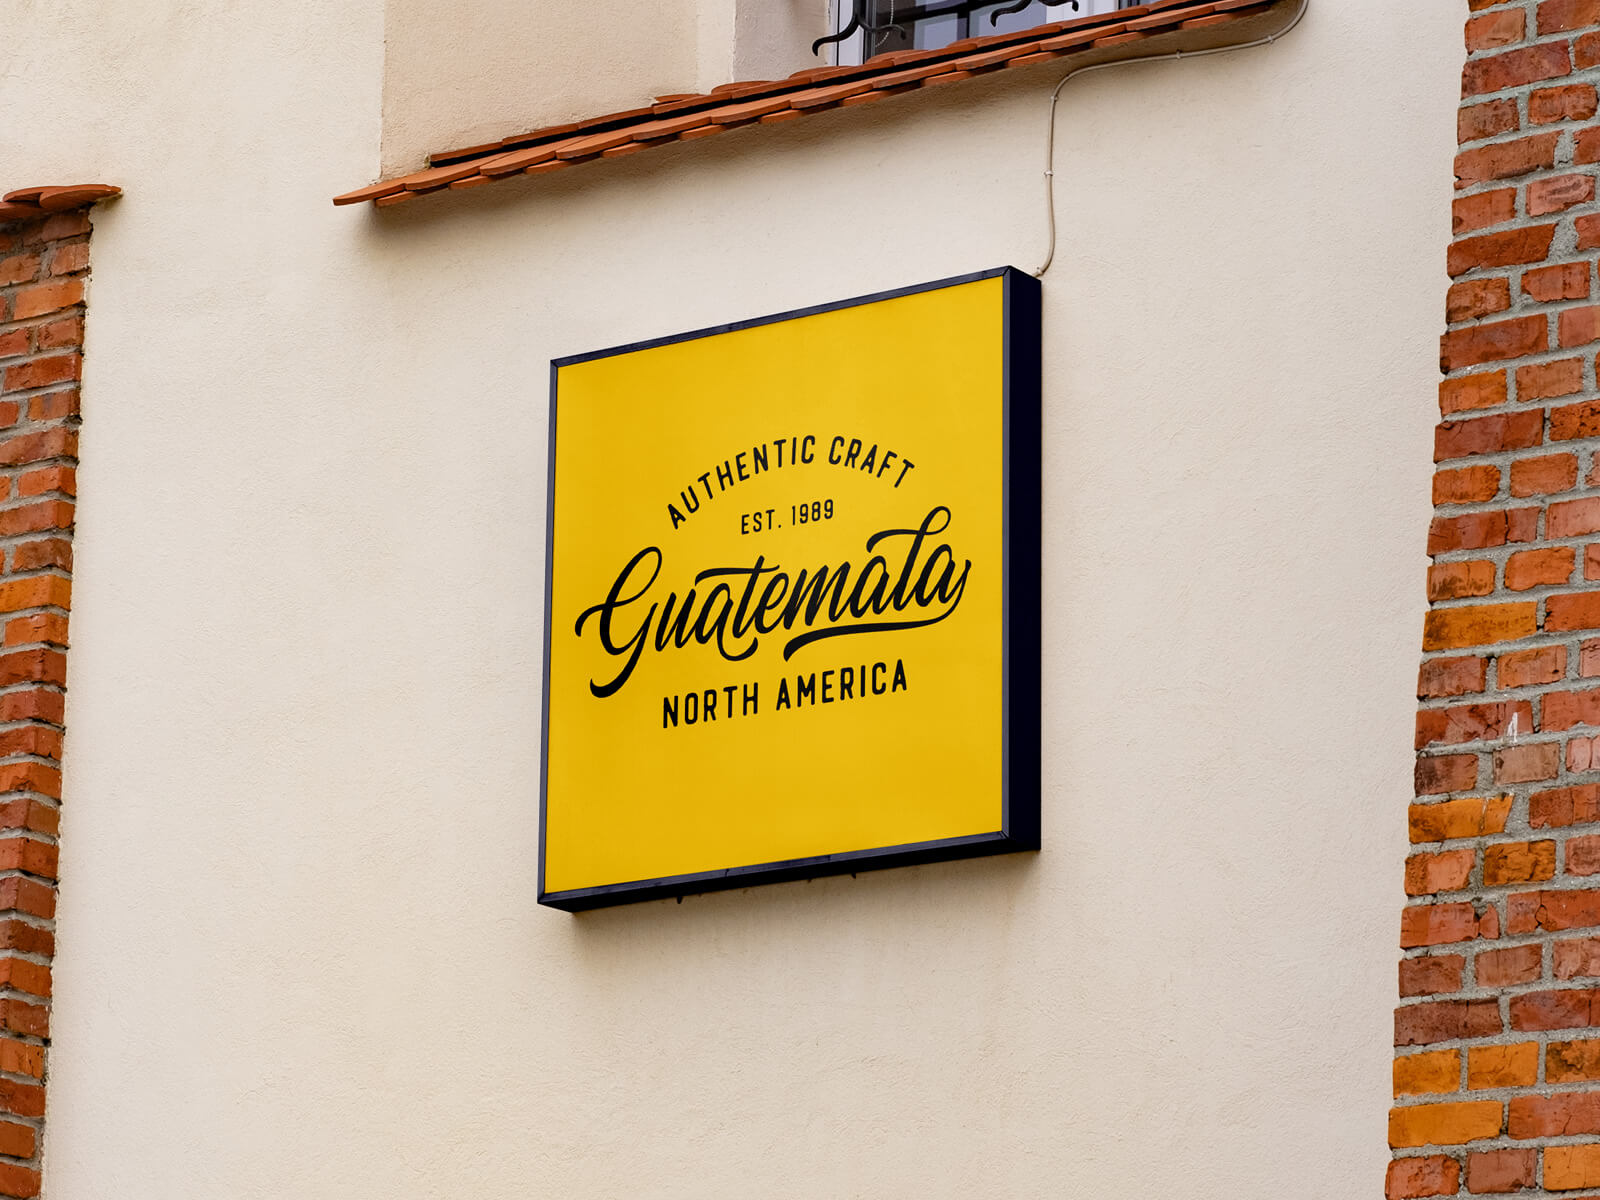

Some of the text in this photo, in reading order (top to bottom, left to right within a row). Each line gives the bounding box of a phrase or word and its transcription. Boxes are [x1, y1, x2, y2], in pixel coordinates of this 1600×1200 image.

[667, 435, 915, 529] AUTHENTIC CRAFT
[740, 498, 835, 535] EST. 1989
[574, 506, 972, 699] Guatemala
[663, 659, 908, 729] NORTH AMERICA
